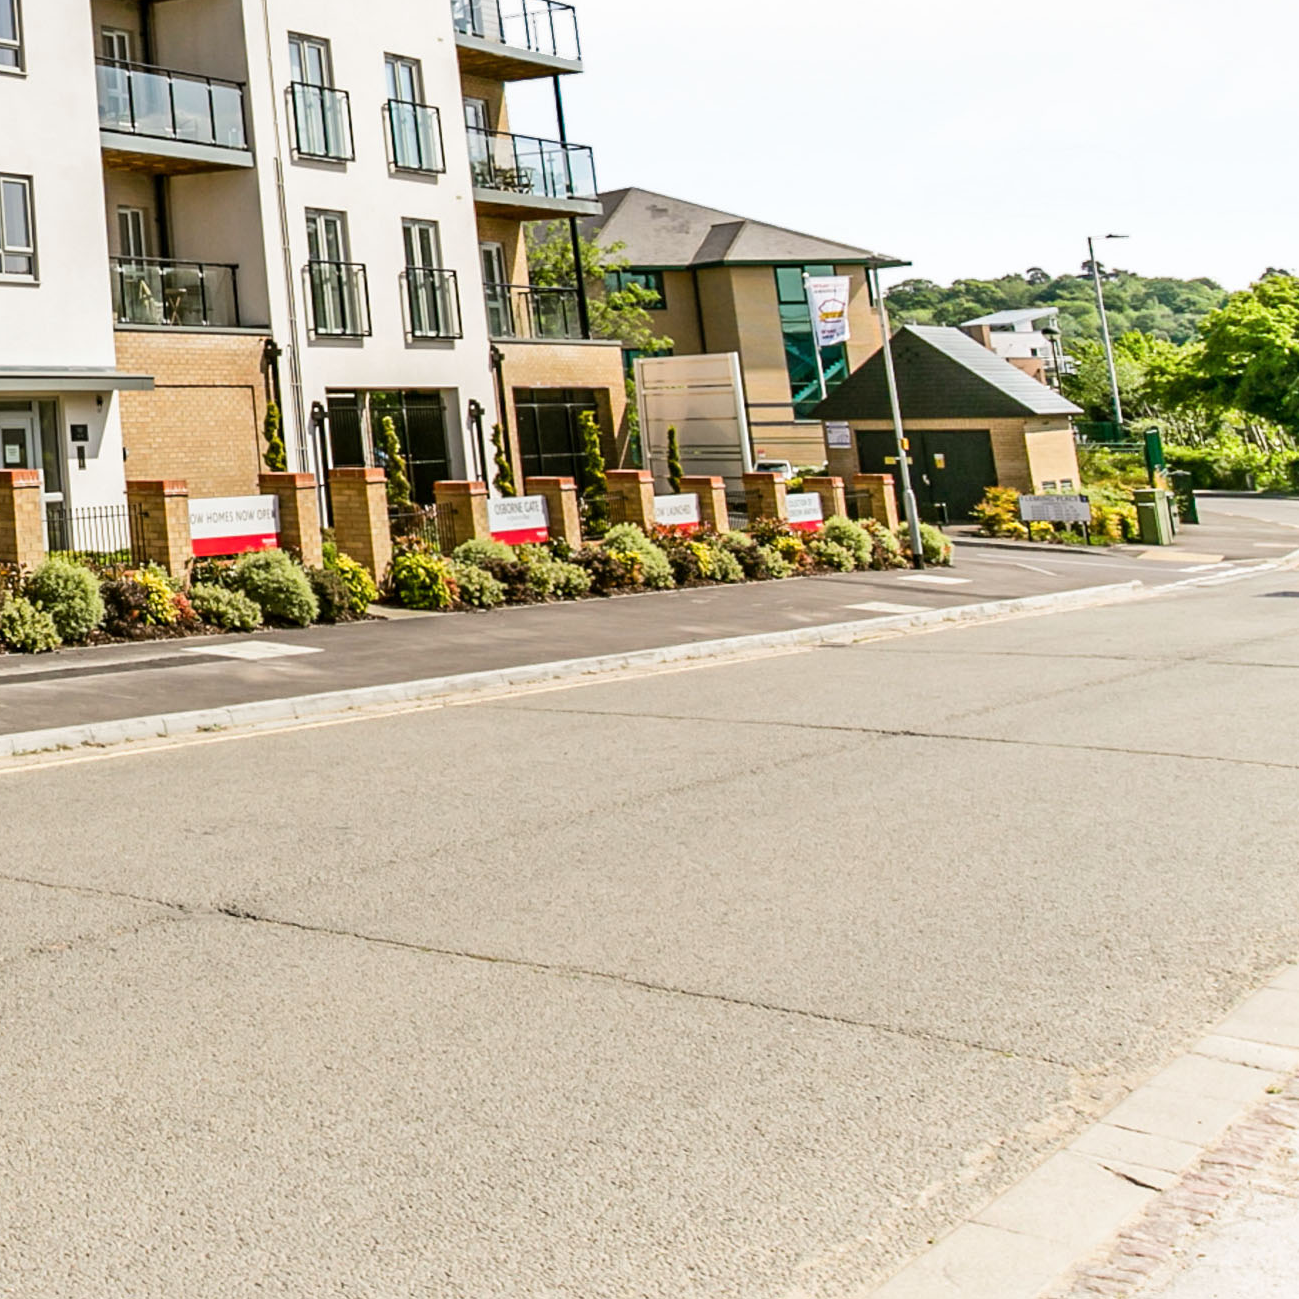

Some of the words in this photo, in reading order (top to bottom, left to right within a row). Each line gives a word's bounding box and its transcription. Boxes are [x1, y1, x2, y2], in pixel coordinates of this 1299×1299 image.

[494, 502, 523, 515] OSBORNE
[524, 501, 539, 513] GATE
[190, 513, 204, 525] OW
[206, 510, 234, 524] HOMES
[235, 508, 256, 522] NOW
[256, 508, 277, 520] OPEN
